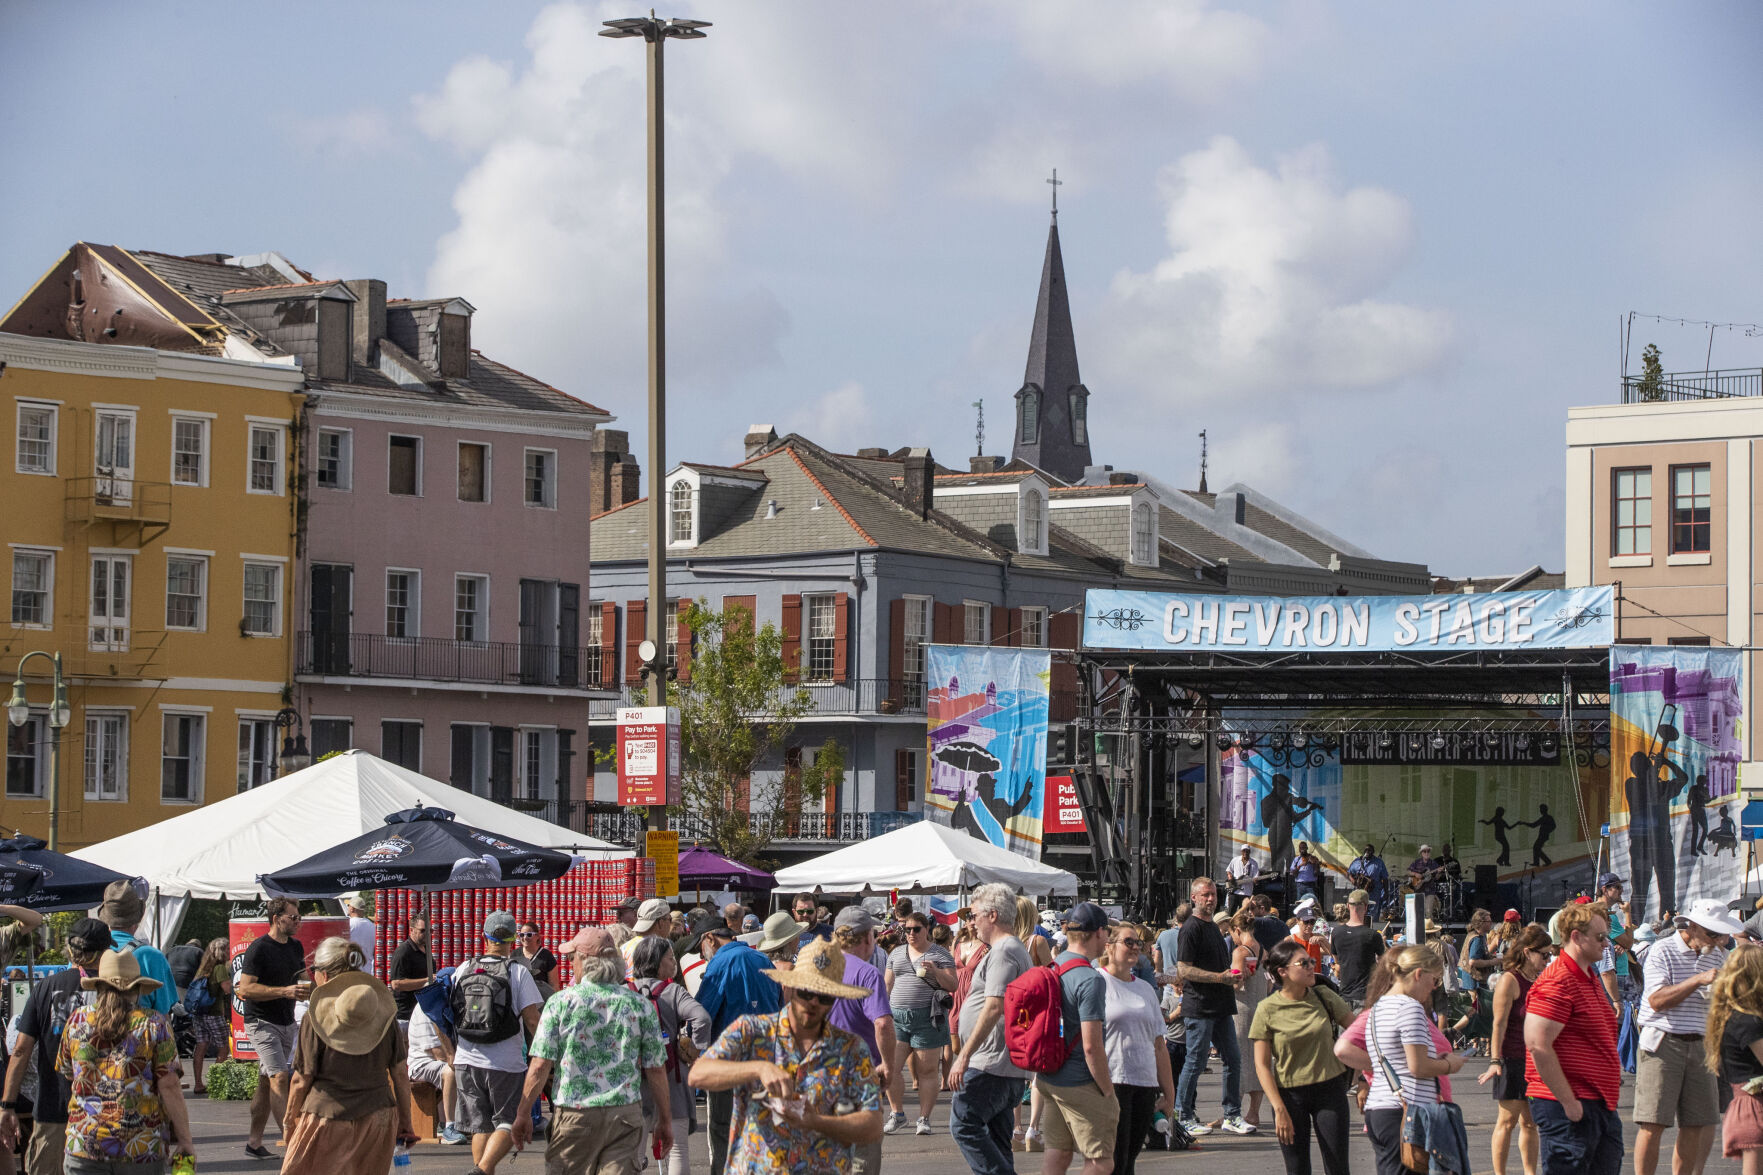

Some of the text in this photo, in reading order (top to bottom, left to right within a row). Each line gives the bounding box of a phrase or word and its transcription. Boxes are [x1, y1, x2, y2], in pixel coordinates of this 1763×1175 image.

[1163, 599, 1537, 647] CHEVRON STAGE
[625, 712, 643, 720] P401
[625, 726, 636, 734] Pay
[643, 725, 658, 733] Park.
[1467, 732, 1534, 760] ESIVL
[1062, 811, 1080, 819] P401
[647, 831, 678, 841] WARNING
[337, 876, 365, 887] Coffee
[371, 872, 408, 884] Chicory
